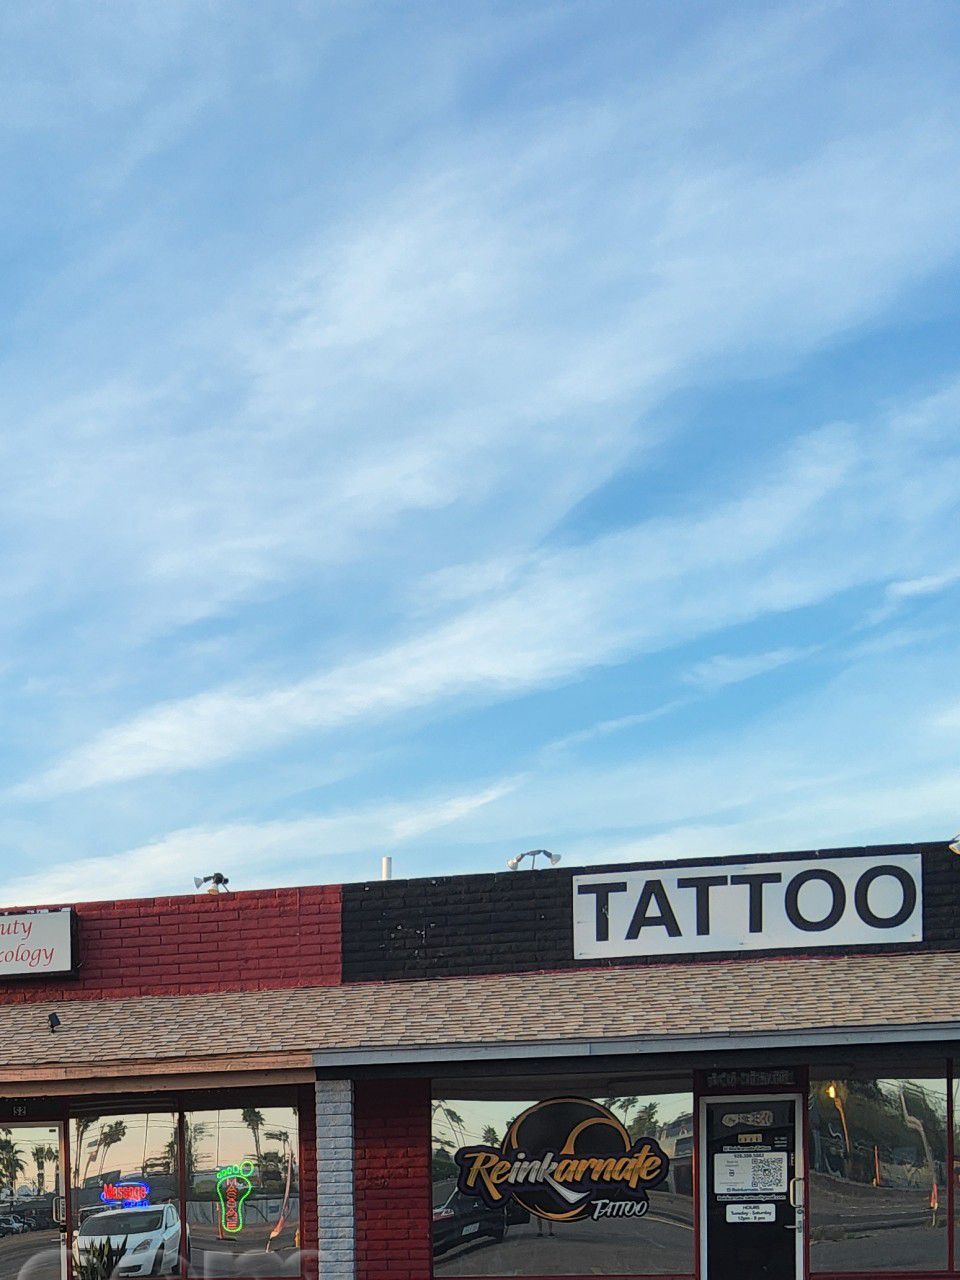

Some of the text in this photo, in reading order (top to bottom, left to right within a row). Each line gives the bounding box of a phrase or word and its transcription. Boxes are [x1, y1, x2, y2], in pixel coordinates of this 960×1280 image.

[577, 864, 917, 942] TATTOO
[103, 1183, 147, 1202] Massage
[464, 1144, 662, 1202] Reinkarnate
[226, 1178, 238, 1230] MASSAGE
